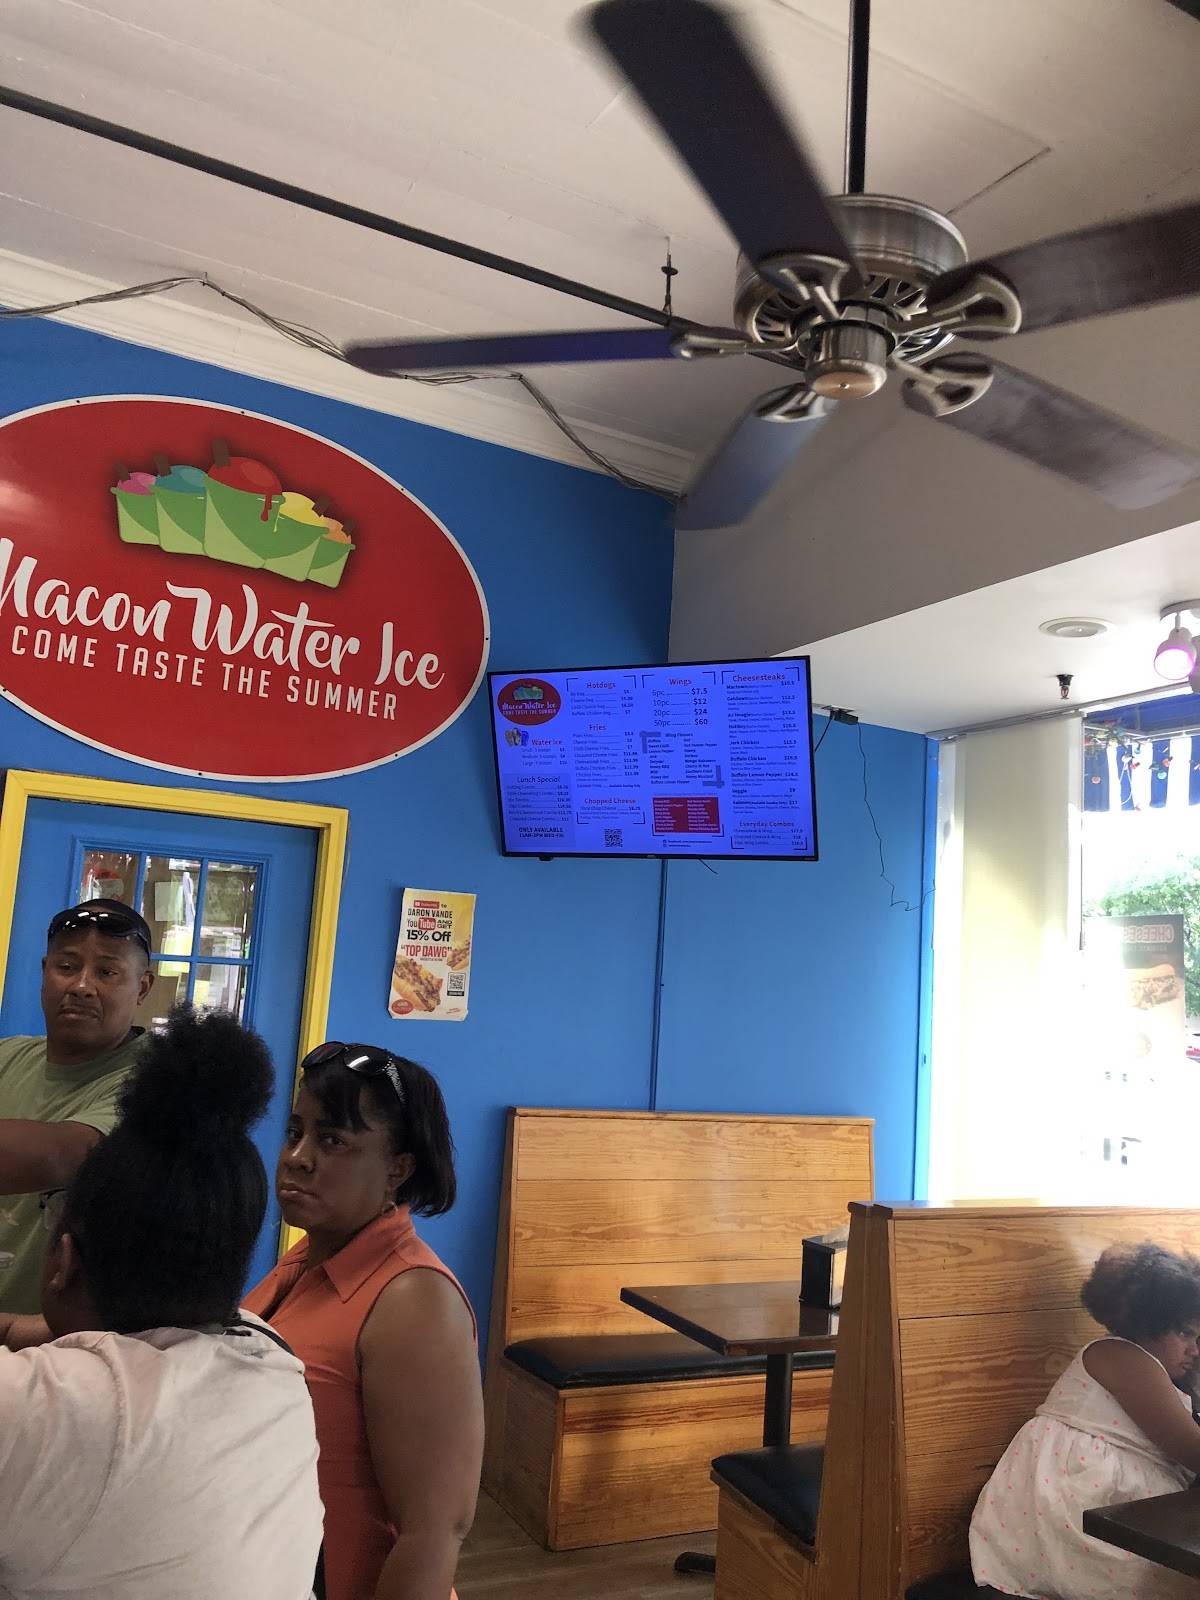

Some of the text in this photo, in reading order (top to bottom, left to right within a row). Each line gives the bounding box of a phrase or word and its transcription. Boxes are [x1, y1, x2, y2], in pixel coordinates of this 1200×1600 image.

[166, 580, 360, 676] Water
[374, 621, 446, 690] Ice
[12, 625, 398, 721] COME TASTE THE SUMMER
[732, 672, 786, 682] Cheesesteaks
[586, 681, 616, 690] Hotdogs
[669, 679, 692, 687] Wings
[691, 687, 708, 695] $7.5
[653, 698, 707, 707] 10pc $12
[653, 708, 708, 717] 20pc $24
[589, 723, 607, 731] Fries
[654, 718, 708, 727] 50pc $60
[537, 776, 561, 784] Special
[584, 797, 612, 806] Chopped
[739, 821, 768, 830] Everyday
[407, 908, 453, 919] DARON VANDE
[406, 929, 452, 942] 15% Off
